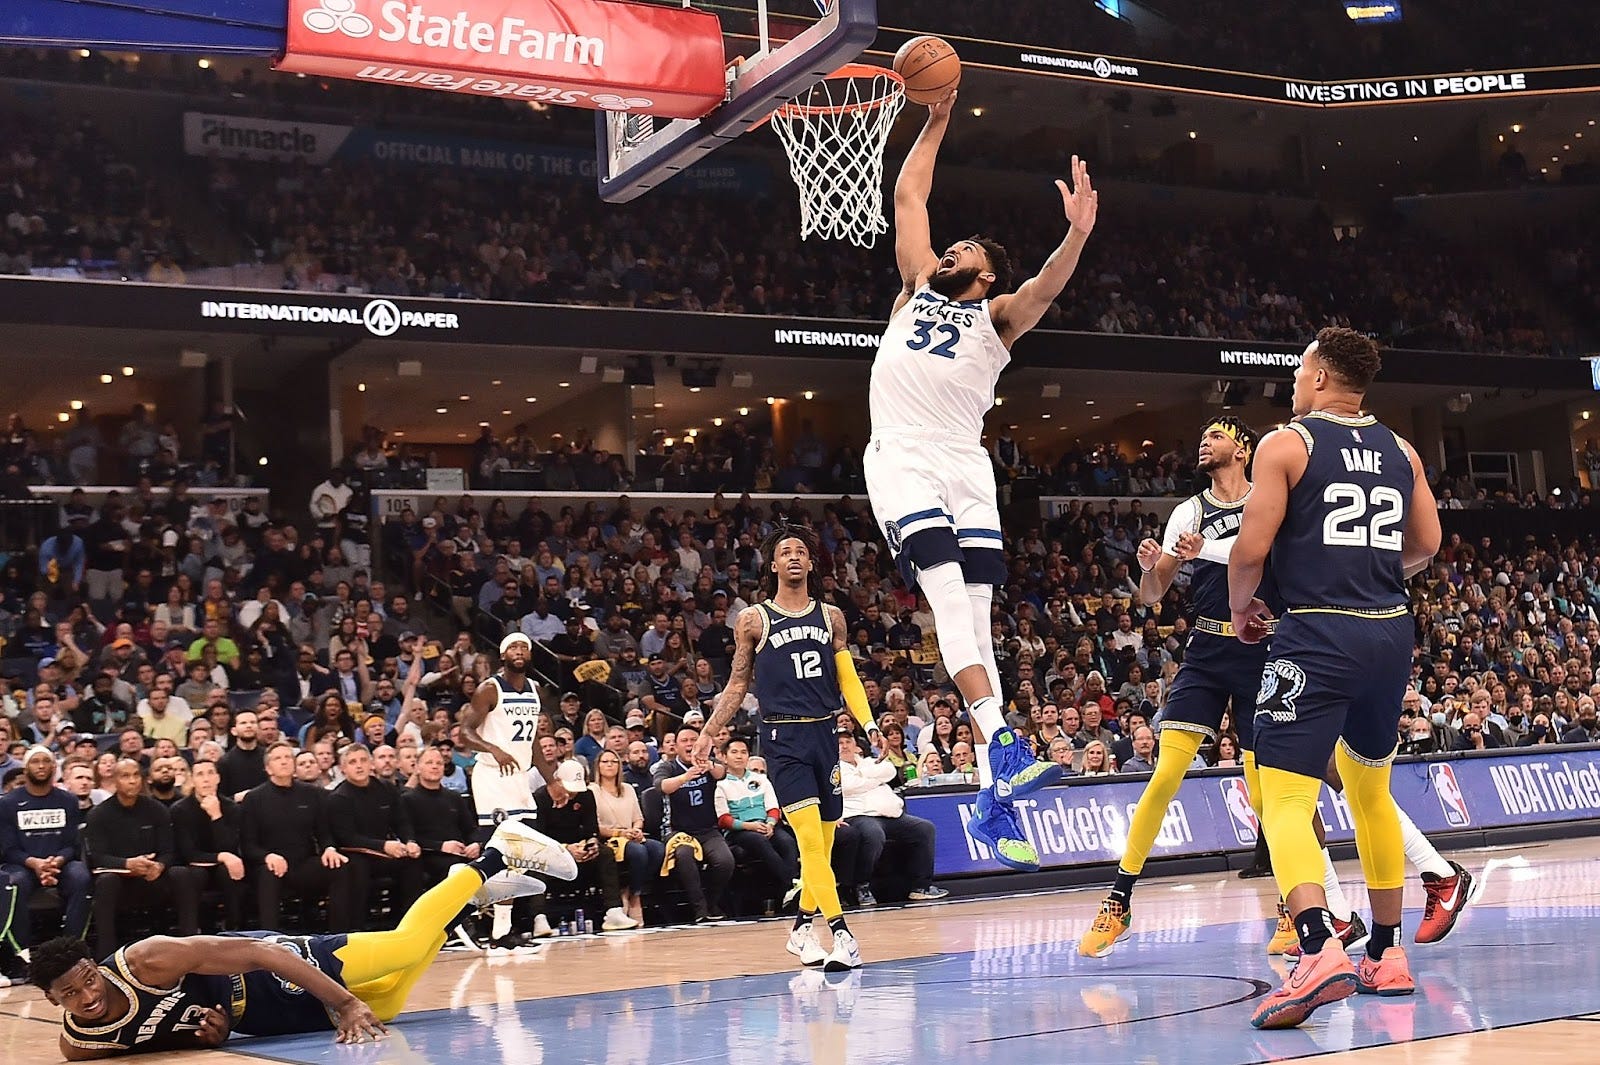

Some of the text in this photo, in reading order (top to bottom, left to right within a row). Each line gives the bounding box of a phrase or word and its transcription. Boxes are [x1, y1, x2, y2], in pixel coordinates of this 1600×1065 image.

[378, 0, 605, 67] StateFarm
[1020, 53, 1139, 77] INTERNATIONAL PAPER
[1286, 73, 1526, 101] INVESTING IN PEOPLE
[202, 118, 316, 154] Pinnacle
[375, 141, 454, 165] OFFICIAL
[460, 147, 507, 169] BANK
[512, 153, 535, 172] OF
[541, 155, 572, 176] THE
[201, 301, 460, 328] INTERNATIONAL PAPER
[775, 329, 881, 348] INTERNATION
[906, 318, 961, 360] 32
[1220, 350, 1304, 367] INTERNATION
[1340, 447, 1382, 475] BANE
[386, 498, 411, 512] 105
[1057, 503, 1070, 515] 10
[1323, 482, 1404, 552] 22
[1201, 512, 1243, 541] MEM
[768, 625, 830, 649] MEMPHIS
[790, 650, 823, 680] 12
[511, 719, 534, 742] 22
[688, 789, 704, 807] 12
[1489, 761, 1600, 816] NBATicket
